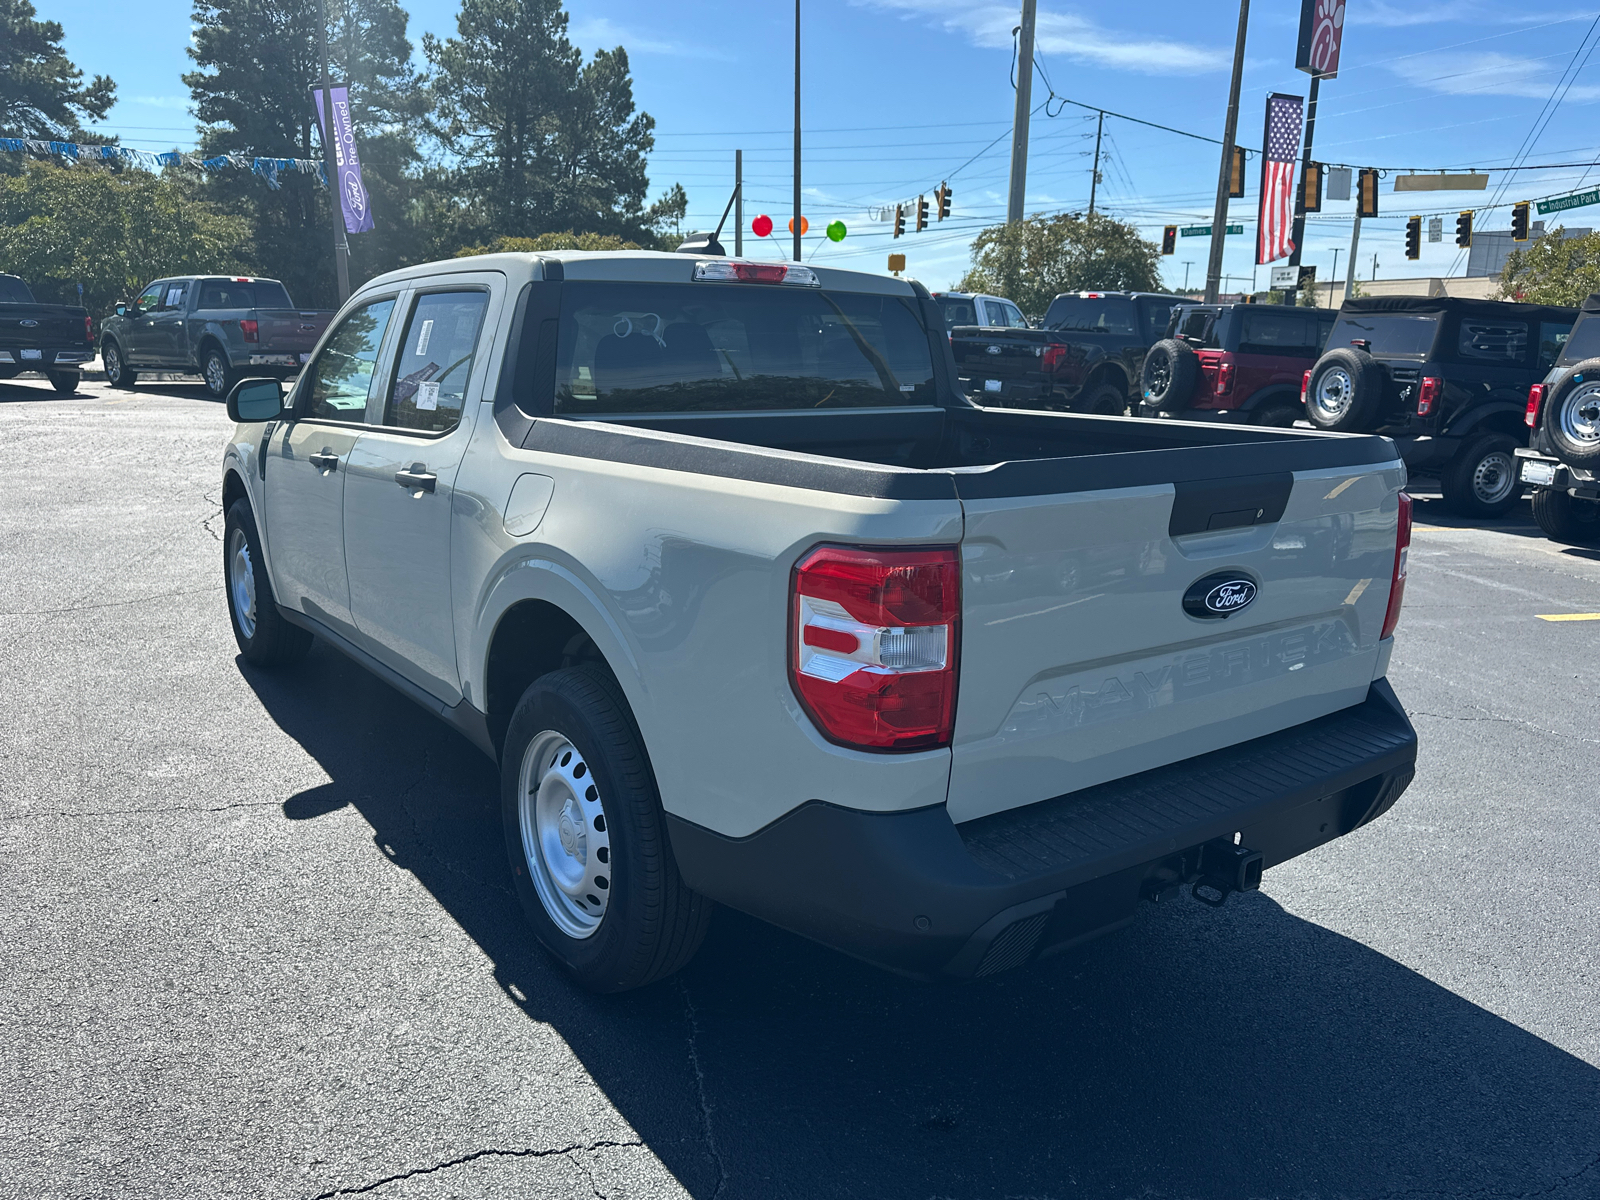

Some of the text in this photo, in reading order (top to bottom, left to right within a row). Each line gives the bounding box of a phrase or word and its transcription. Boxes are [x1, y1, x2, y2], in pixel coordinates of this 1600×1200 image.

[335, 101, 358, 165] Pre-Owned
[347, 181, 363, 211] Ford
[1548, 196, 1580, 211] Industrial
[1580, 192, 1597, 205] Park
[1183, 228, 1207, 236] Dames
[1232, 226, 1242, 234] Rd
[1215, 584, 1248, 608] Ford
[1036, 623, 1338, 720] MAVERICK
